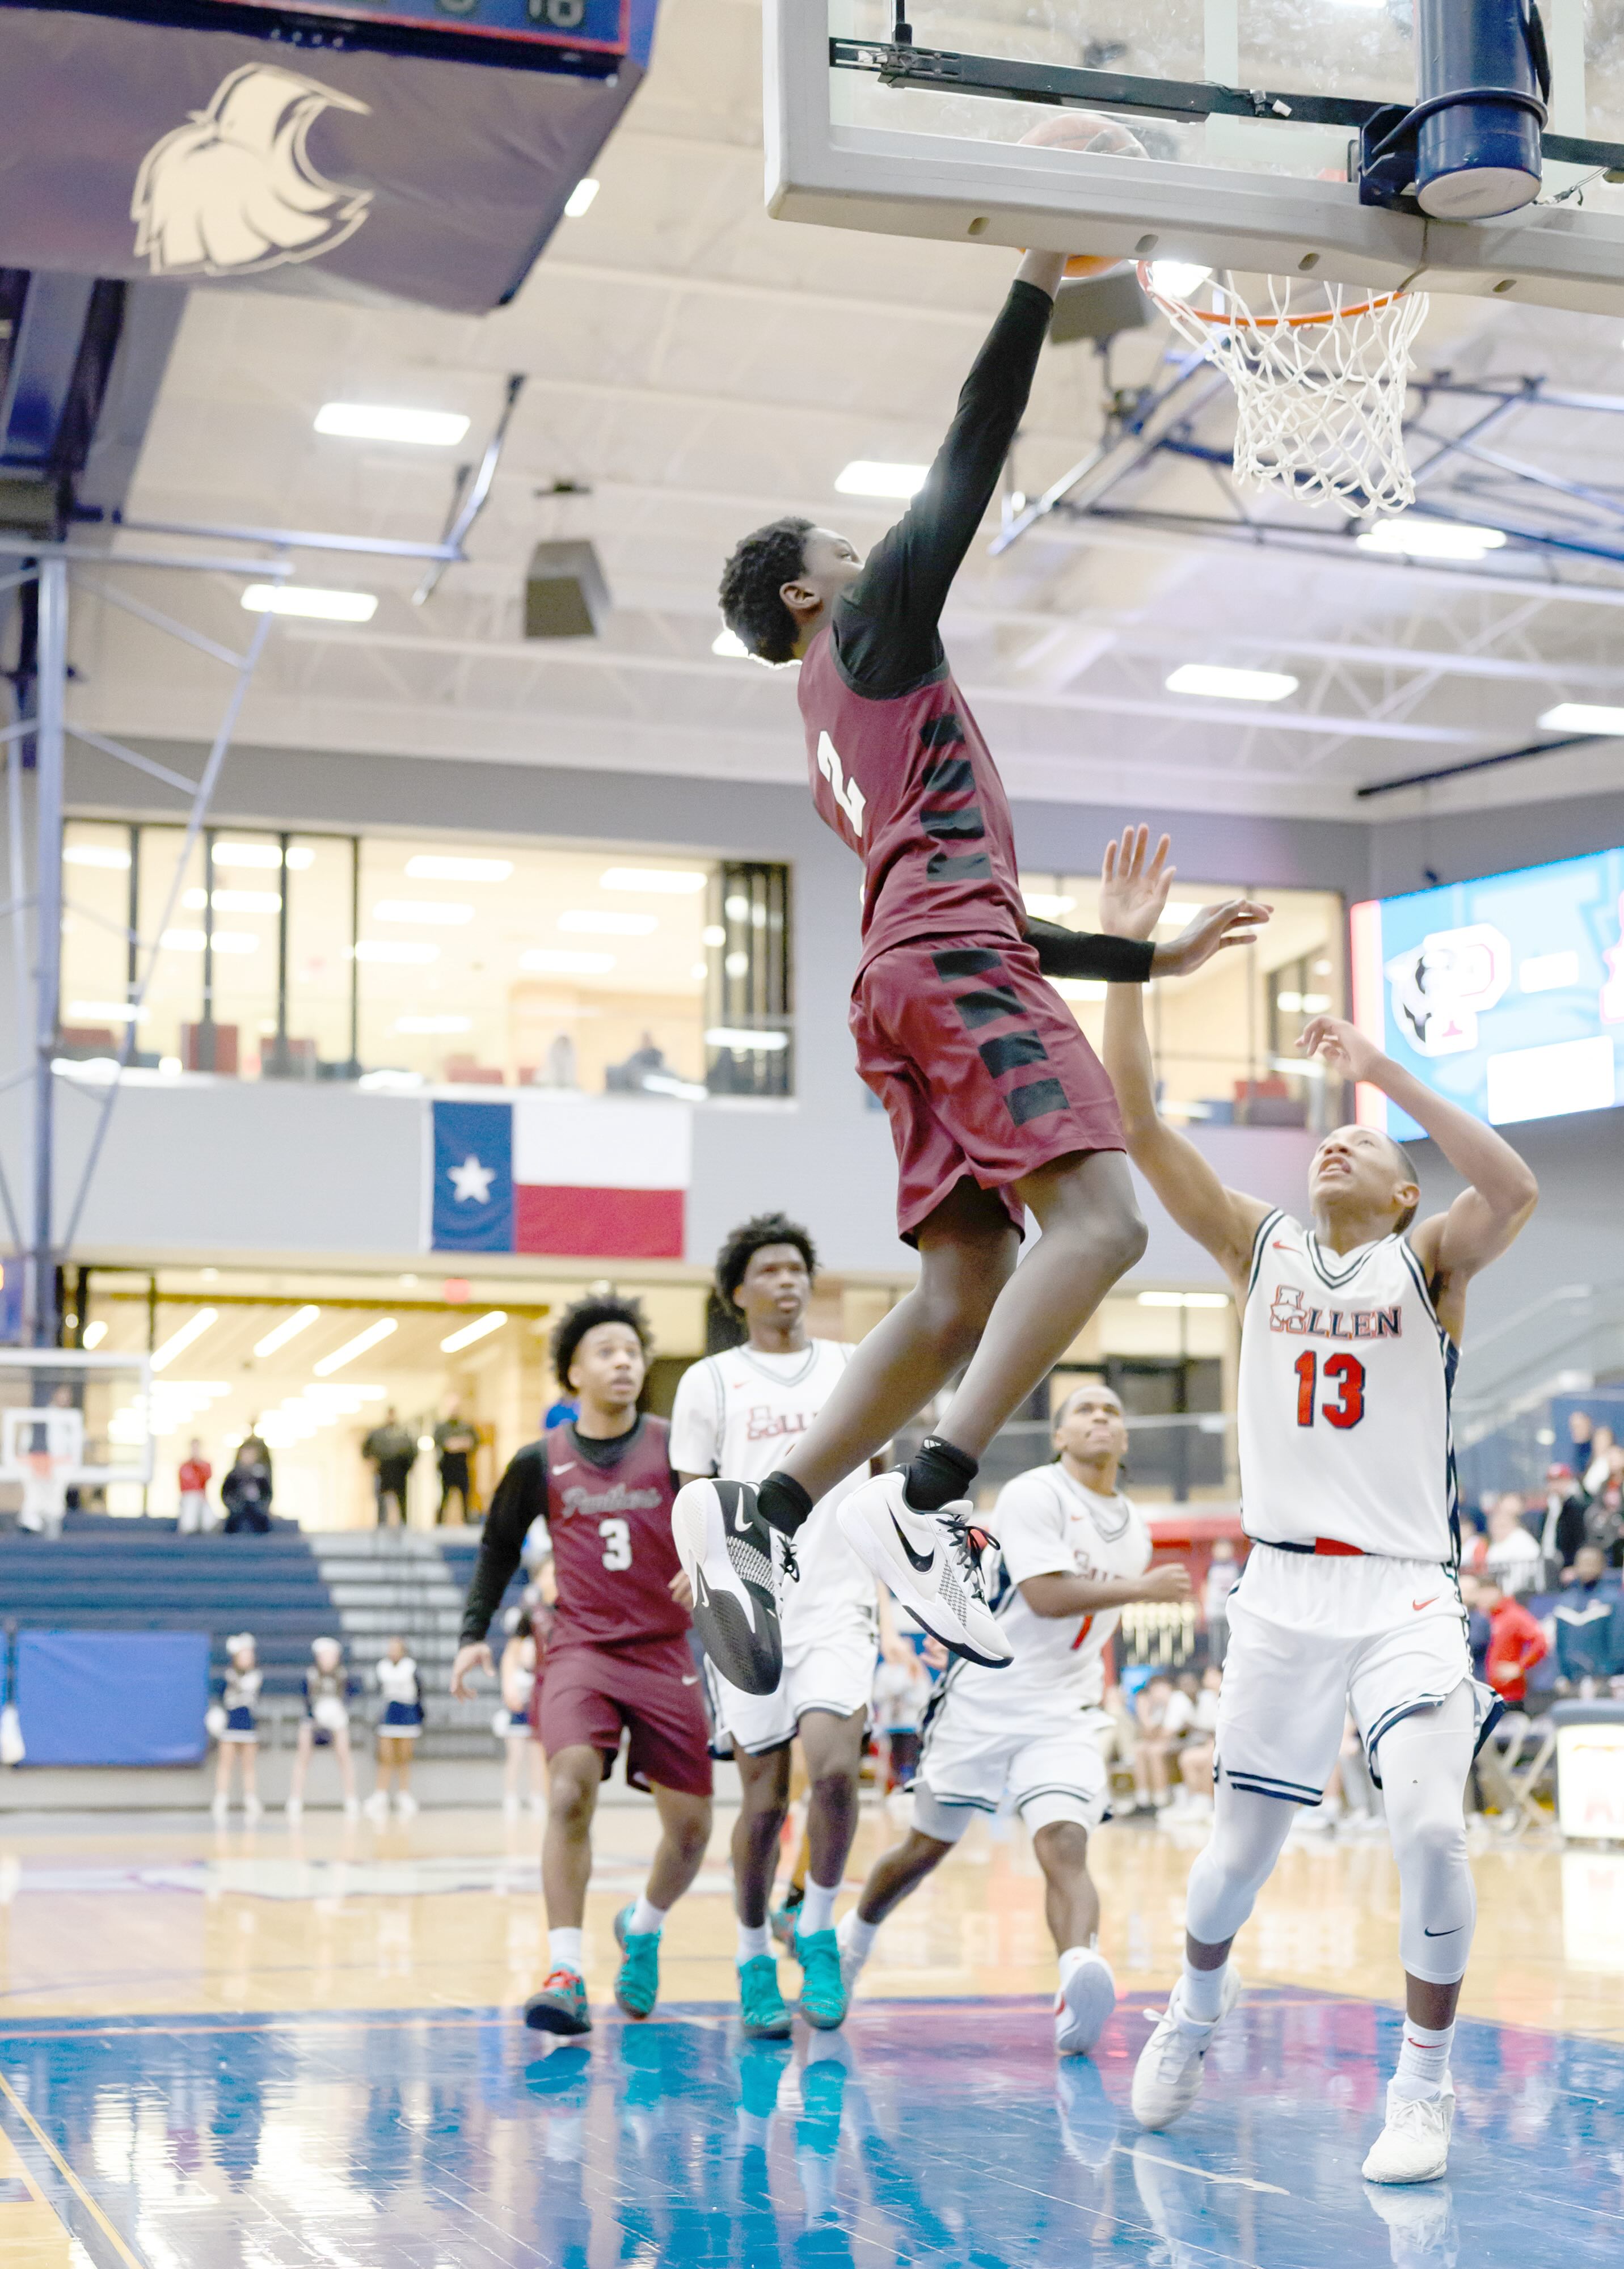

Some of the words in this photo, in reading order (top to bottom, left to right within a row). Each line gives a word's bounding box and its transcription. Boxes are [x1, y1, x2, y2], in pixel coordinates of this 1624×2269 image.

[1269, 1284, 1402, 1340] ALLEN
[1294, 1349, 1366, 1430] 13
[599, 1518, 632, 1571] 3
